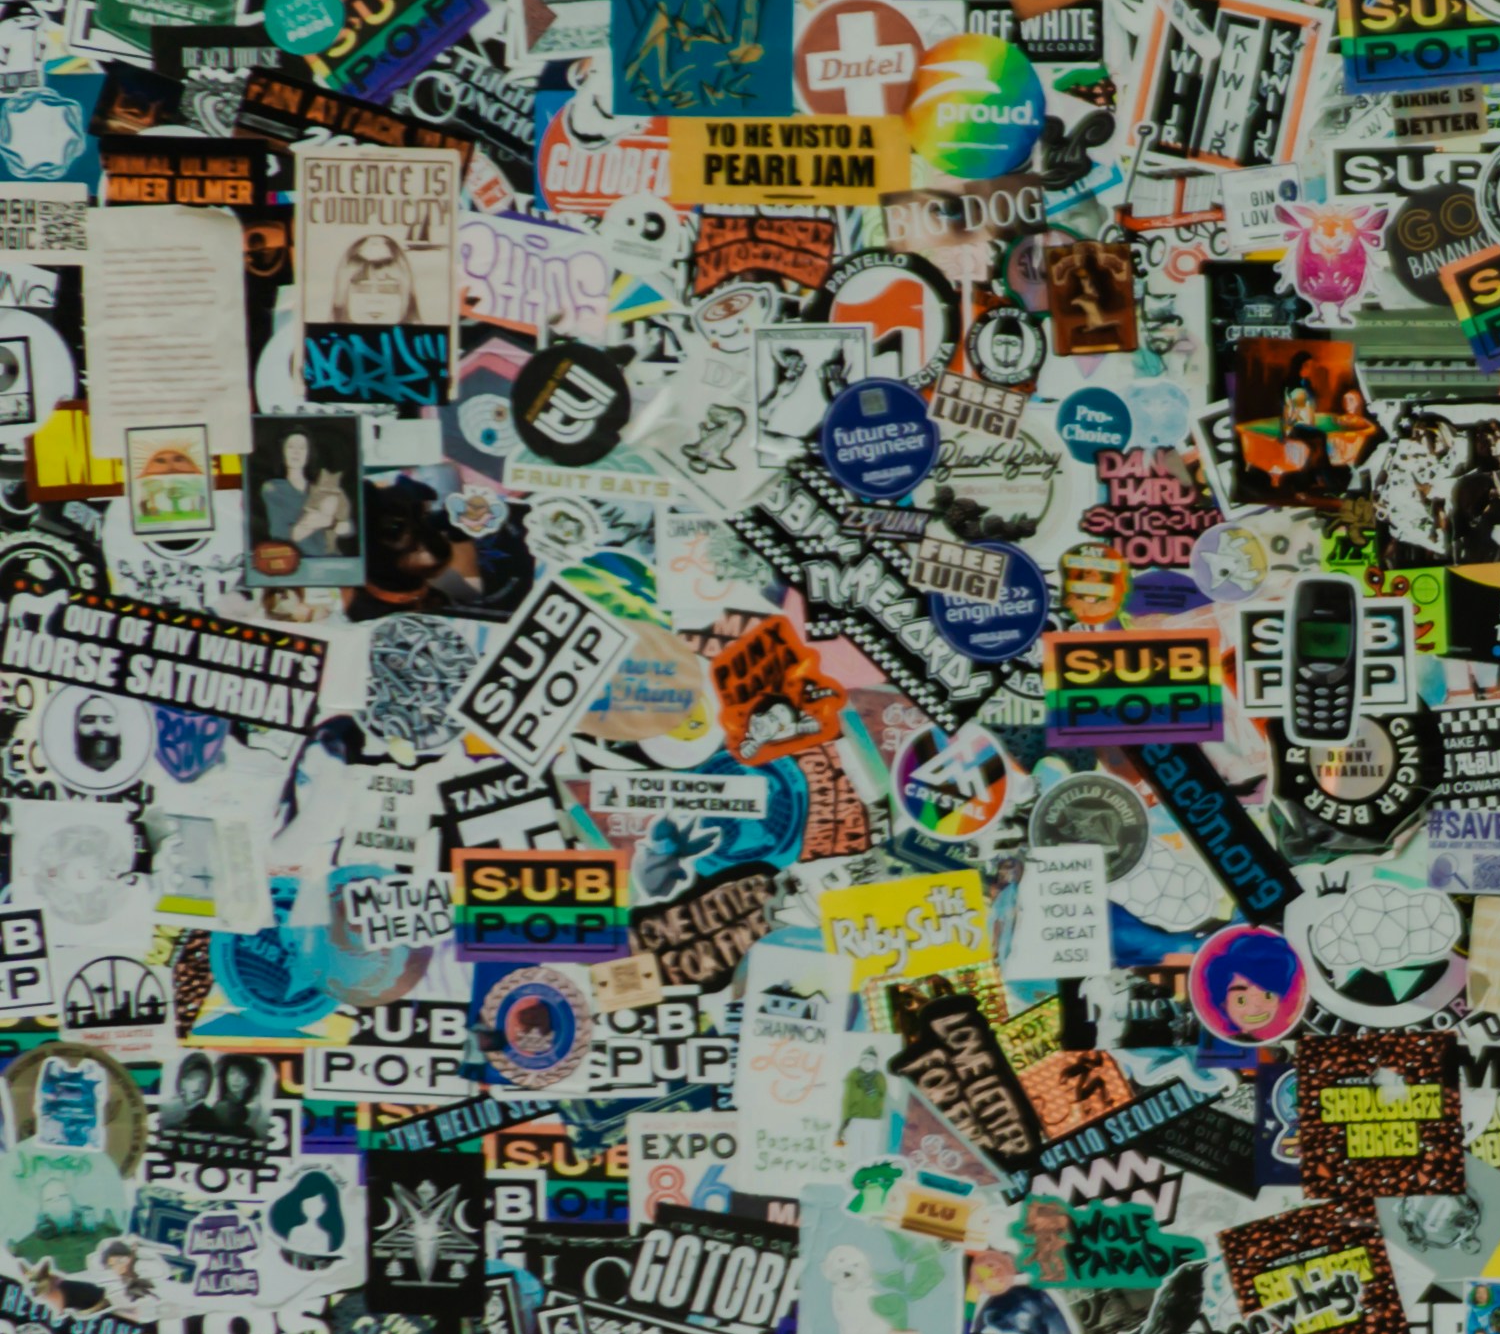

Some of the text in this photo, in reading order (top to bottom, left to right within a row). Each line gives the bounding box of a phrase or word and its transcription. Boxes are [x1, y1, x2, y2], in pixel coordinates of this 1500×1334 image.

[968, 8, 1095, 41] OFF WHITE
[938, 97, 1038, 129] proud.
[707, 124, 873, 148] YO HE VISTO A
[705, 155, 874, 187] PEARL JAM
[885, 186, 1041, 245] BIG DOG
[936, 373, 1026, 421] FREE
[933, 392, 1017, 437] LUIGI
[628, 779, 724, 795] YOU KNOW
[626, 796, 662, 810] BRET
[1039, 881, 1093, 896] I GAVE
[1042, 904, 1094, 918] YOU A
[1041, 925, 1096, 941] GREAT
[1053, 948, 1089, 963] ASS!
[641, 1134, 735, 1160] EXPO
